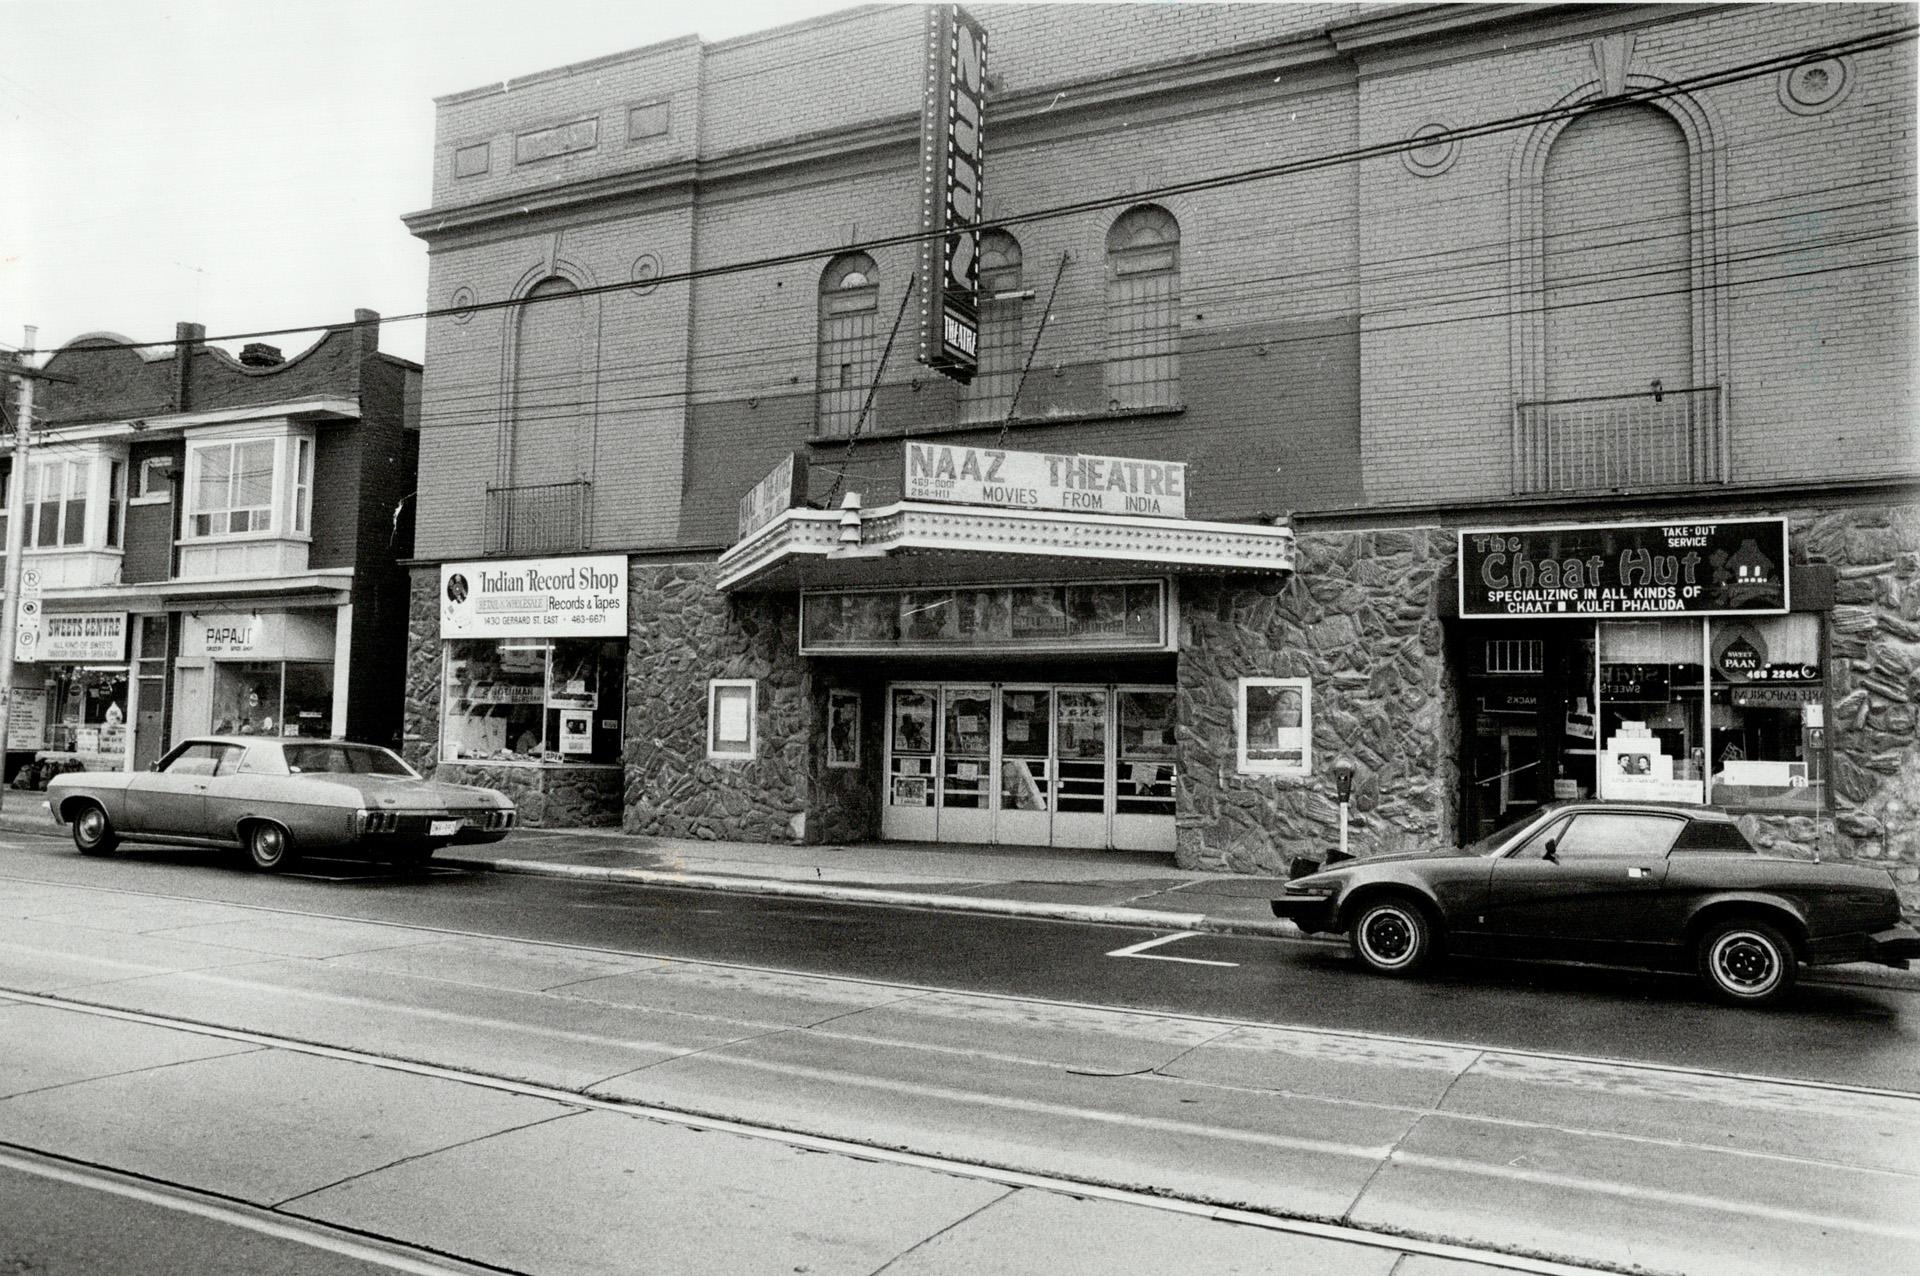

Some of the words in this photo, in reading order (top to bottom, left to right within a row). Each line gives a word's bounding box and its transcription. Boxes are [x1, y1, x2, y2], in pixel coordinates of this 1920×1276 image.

[944, 314, 977, 357] THEATRE
[910, 445, 1006, 483] NAAZ
[1044, 456, 1182, 497] THEATRE
[982, 486, 1038, 504] MOVIES
[1063, 492, 1102, 509] FROM
[1125, 496, 1161, 513] INDIA
[1662, 526, 1717, 537] TAKE-OUT
[1472, 534, 1521, 553] The
[1668, 537, 1707, 547] SERVICE
[1481, 553, 1604, 589] Chaat
[1619, 548, 1701, 585] Hut
[479, 570, 524, 593] Indian
[527, 568, 575, 592] Record
[579, 567, 619, 594] Shop
[1488, 588, 1578, 602] SPECIALIZING
[1584, 588, 1597, 600] IN
[1602, 588, 1627, 599] ALL
[1634, 586, 1676, 598] KINDS
[1683, 586, 1702, 598] OF
[506, 599, 543, 609] WHOLESALE
[549, 595, 585, 611] Records
[587, 600, 592, 609] &
[593, 595, 620, 614] Tapes
[1508, 601, 1552, 613] CHAAT
[1577, 600, 1614, 612] KULFI
[1622, 599, 1685, 611] PHALUDA
[48, 618, 82, 637] SWEETS
[85, 617, 121, 637] CENTRE
[484, 616, 500, 625] 1430
[502, 616, 531, 625] GERRARD
[543, 615, 559, 624] EAST
[571, 614, 607, 624] 463-6671
[207, 628, 252, 644] PAPAJI
[1725, 660, 1756, 668] PAAN
[546, 752, 563, 761] OPEN
